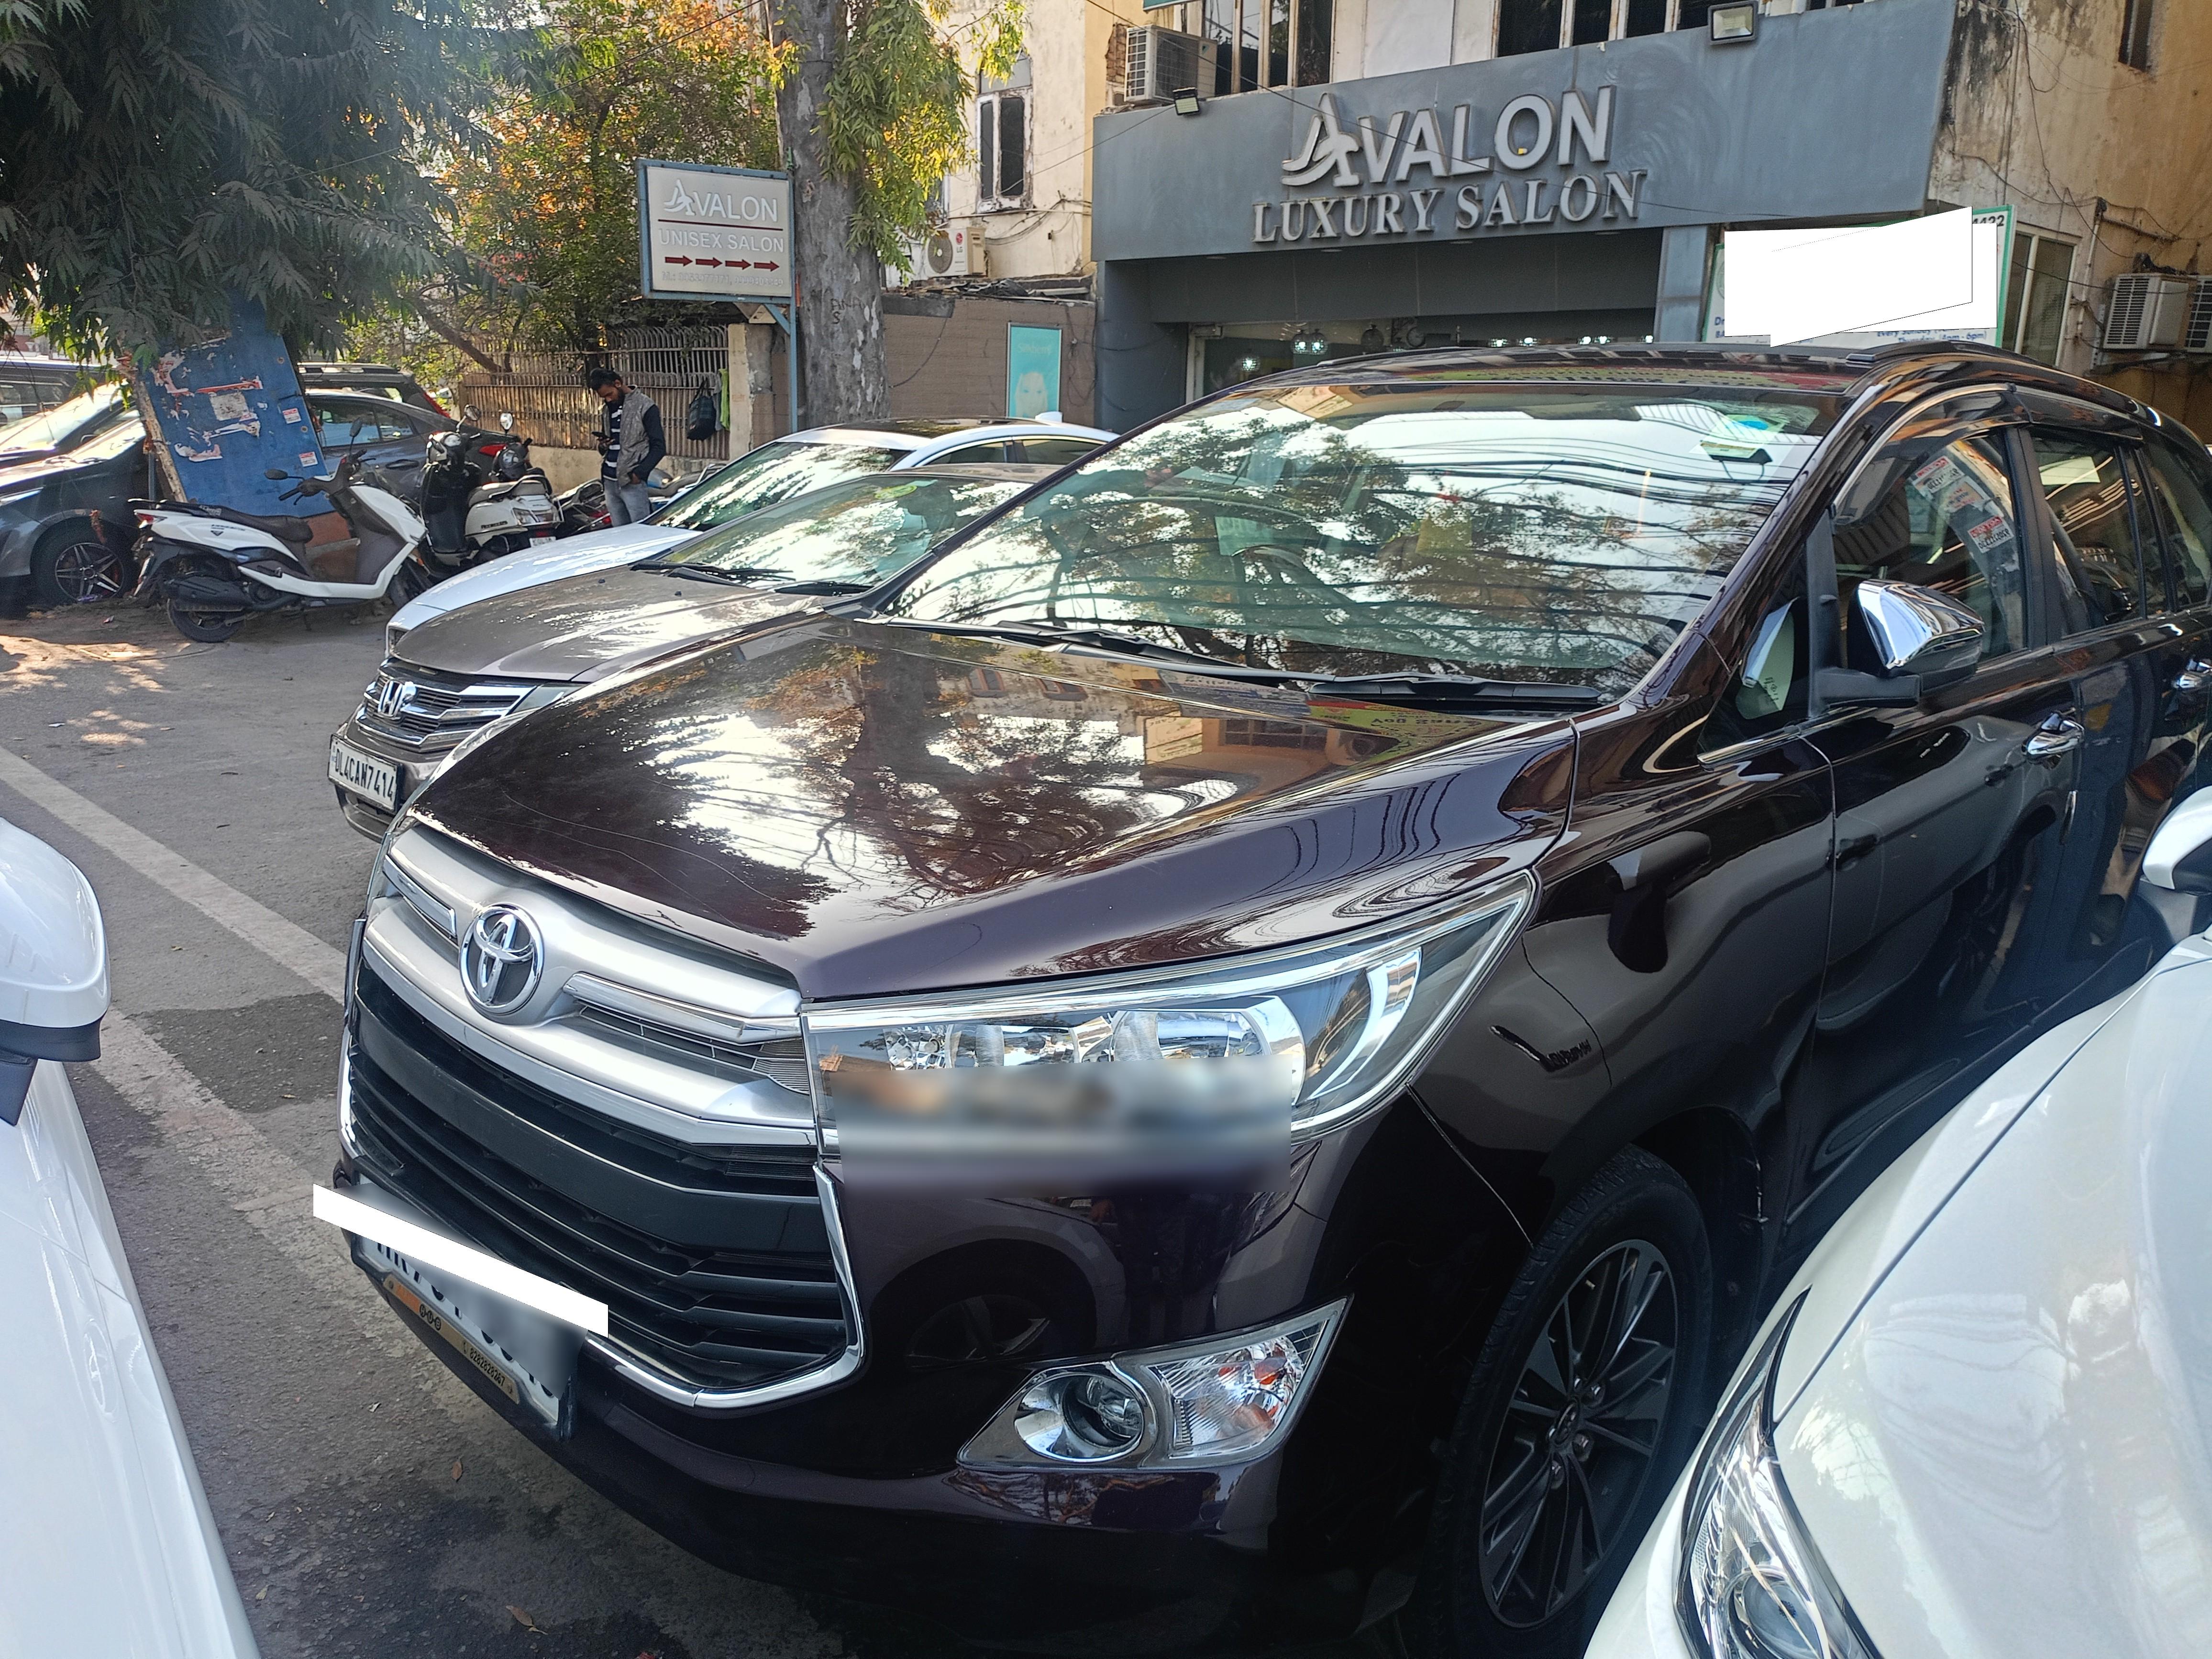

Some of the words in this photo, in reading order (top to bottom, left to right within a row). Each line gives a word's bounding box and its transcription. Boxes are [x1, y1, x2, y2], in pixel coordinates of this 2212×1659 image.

[1281, 85, 1616, 187] AVALON
[663, 179, 778, 222] AVALON
[1251, 188, 1445, 243] LUXURY
[1455, 169, 1648, 231] SALON
[659, 228, 722, 249] UNISEX
[728, 234, 784, 253] SALON
